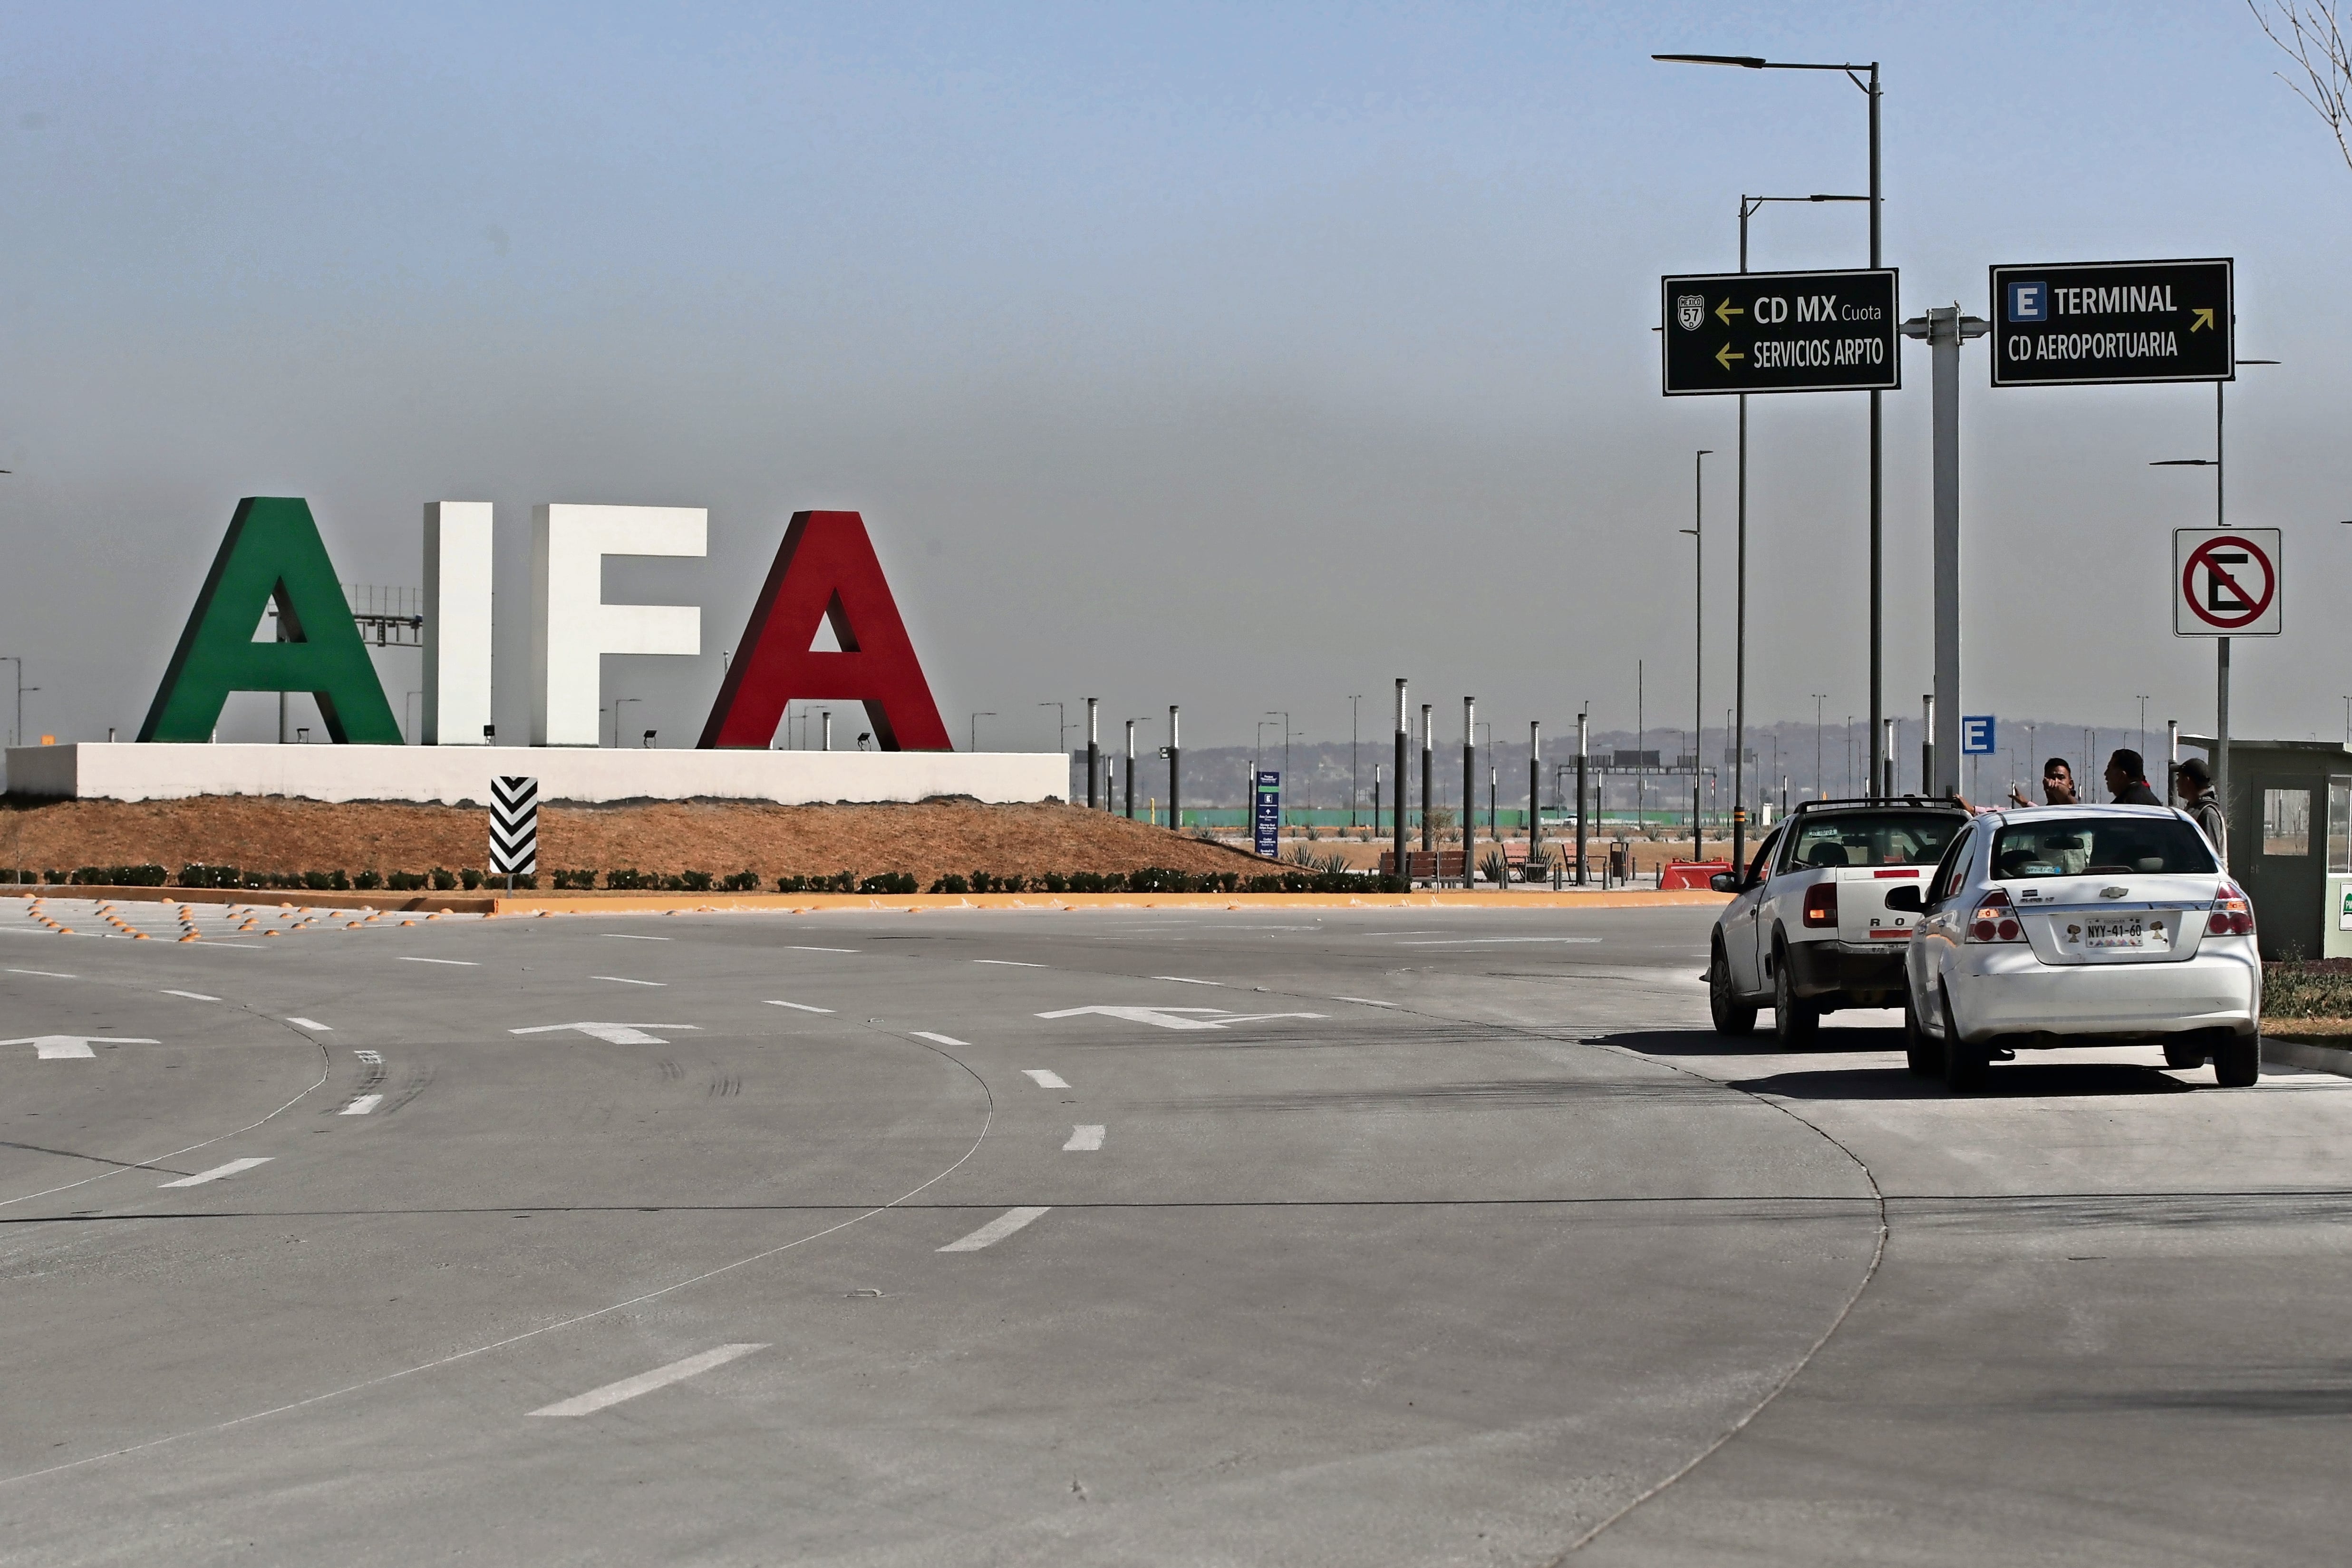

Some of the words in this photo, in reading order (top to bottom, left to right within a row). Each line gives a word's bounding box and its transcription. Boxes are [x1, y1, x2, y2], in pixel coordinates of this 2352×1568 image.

[1754, 297, 1788, 324] CD
[1797, 295, 1837, 322] MX
[1842, 304, 1881, 321] Cuota
[2017, 287, 2038, 316] E
[2054, 285, 2177, 315] TERMINAL
[1684, 309, 1699, 322] 57
[1754, 339, 1830, 368] SERVICIOS
[1834, 337, 1884, 366] ARPTO
[2008, 335, 2031, 361] CD
[2036, 331, 2178, 360] AEROPORTUARIA
[135, 497, 954, 752] AIFA
[1964, 721, 1987, 750] E
[2088, 924, 2141, 938] NYY-41-60
